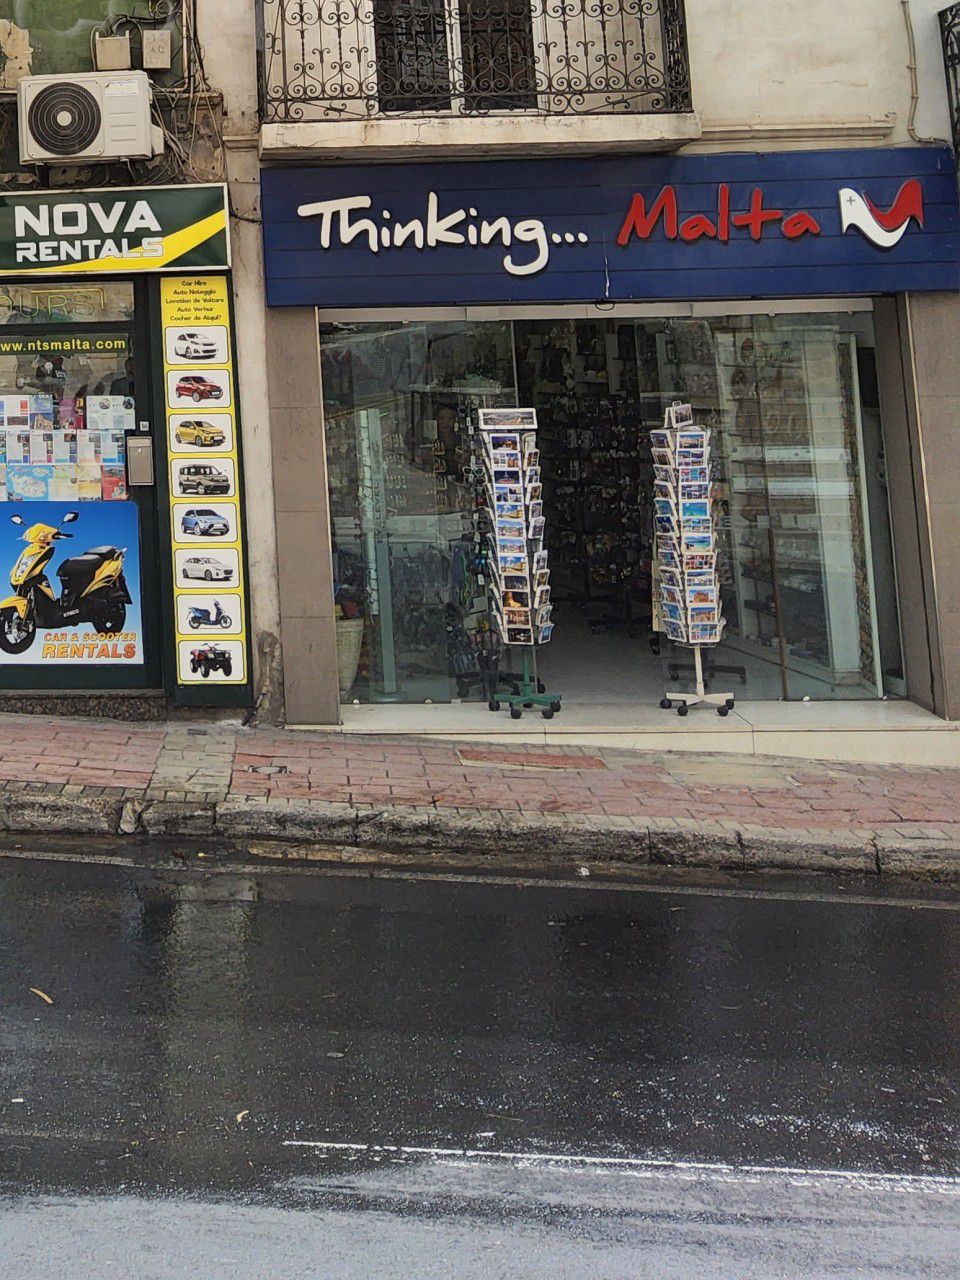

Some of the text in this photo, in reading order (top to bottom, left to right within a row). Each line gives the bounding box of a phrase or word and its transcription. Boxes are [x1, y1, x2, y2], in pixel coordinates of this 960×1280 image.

[14, 200, 162, 238] NOVA
[297, 191, 588, 276] Thinking...
[616, 183, 821, 247] Malta
[16, 237, 164, 262] RENTALS
[44, 632, 136, 642] CAR & SCOOTER
[42, 643, 136, 658] RENTALS
